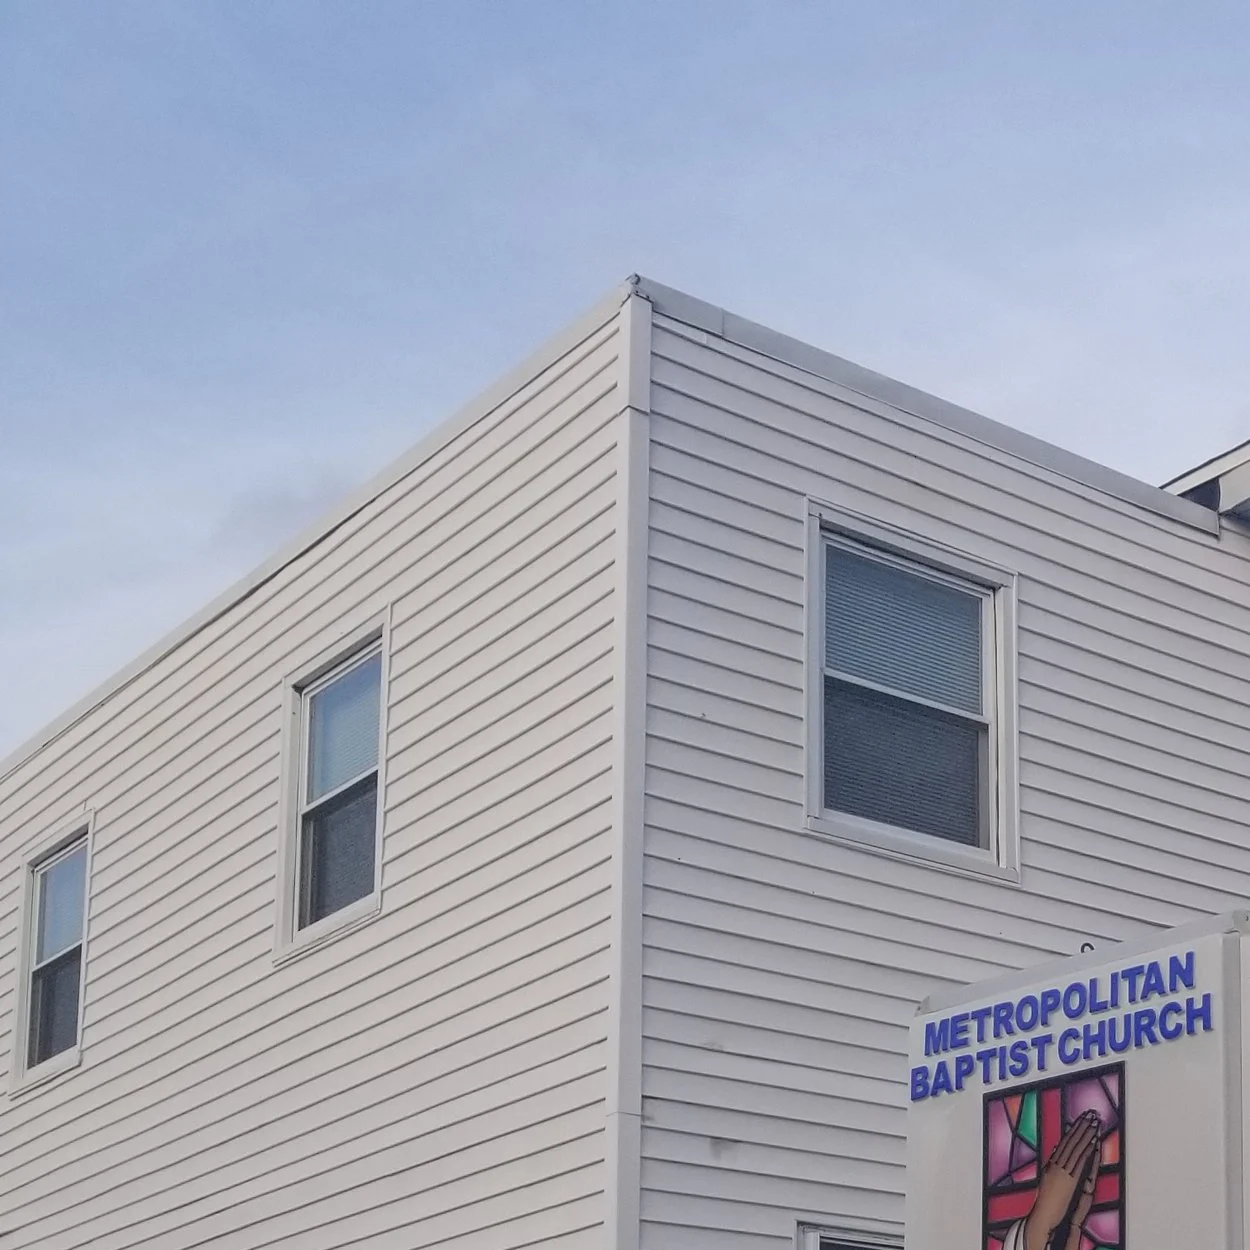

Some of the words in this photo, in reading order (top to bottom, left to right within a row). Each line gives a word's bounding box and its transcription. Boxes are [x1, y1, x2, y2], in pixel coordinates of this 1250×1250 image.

[910, 1034, 1053, 1102] BAPTIST
[1057, 992, 1213, 1065] CHURCH
[924, 951, 1195, 1057] METROPOLITAN
